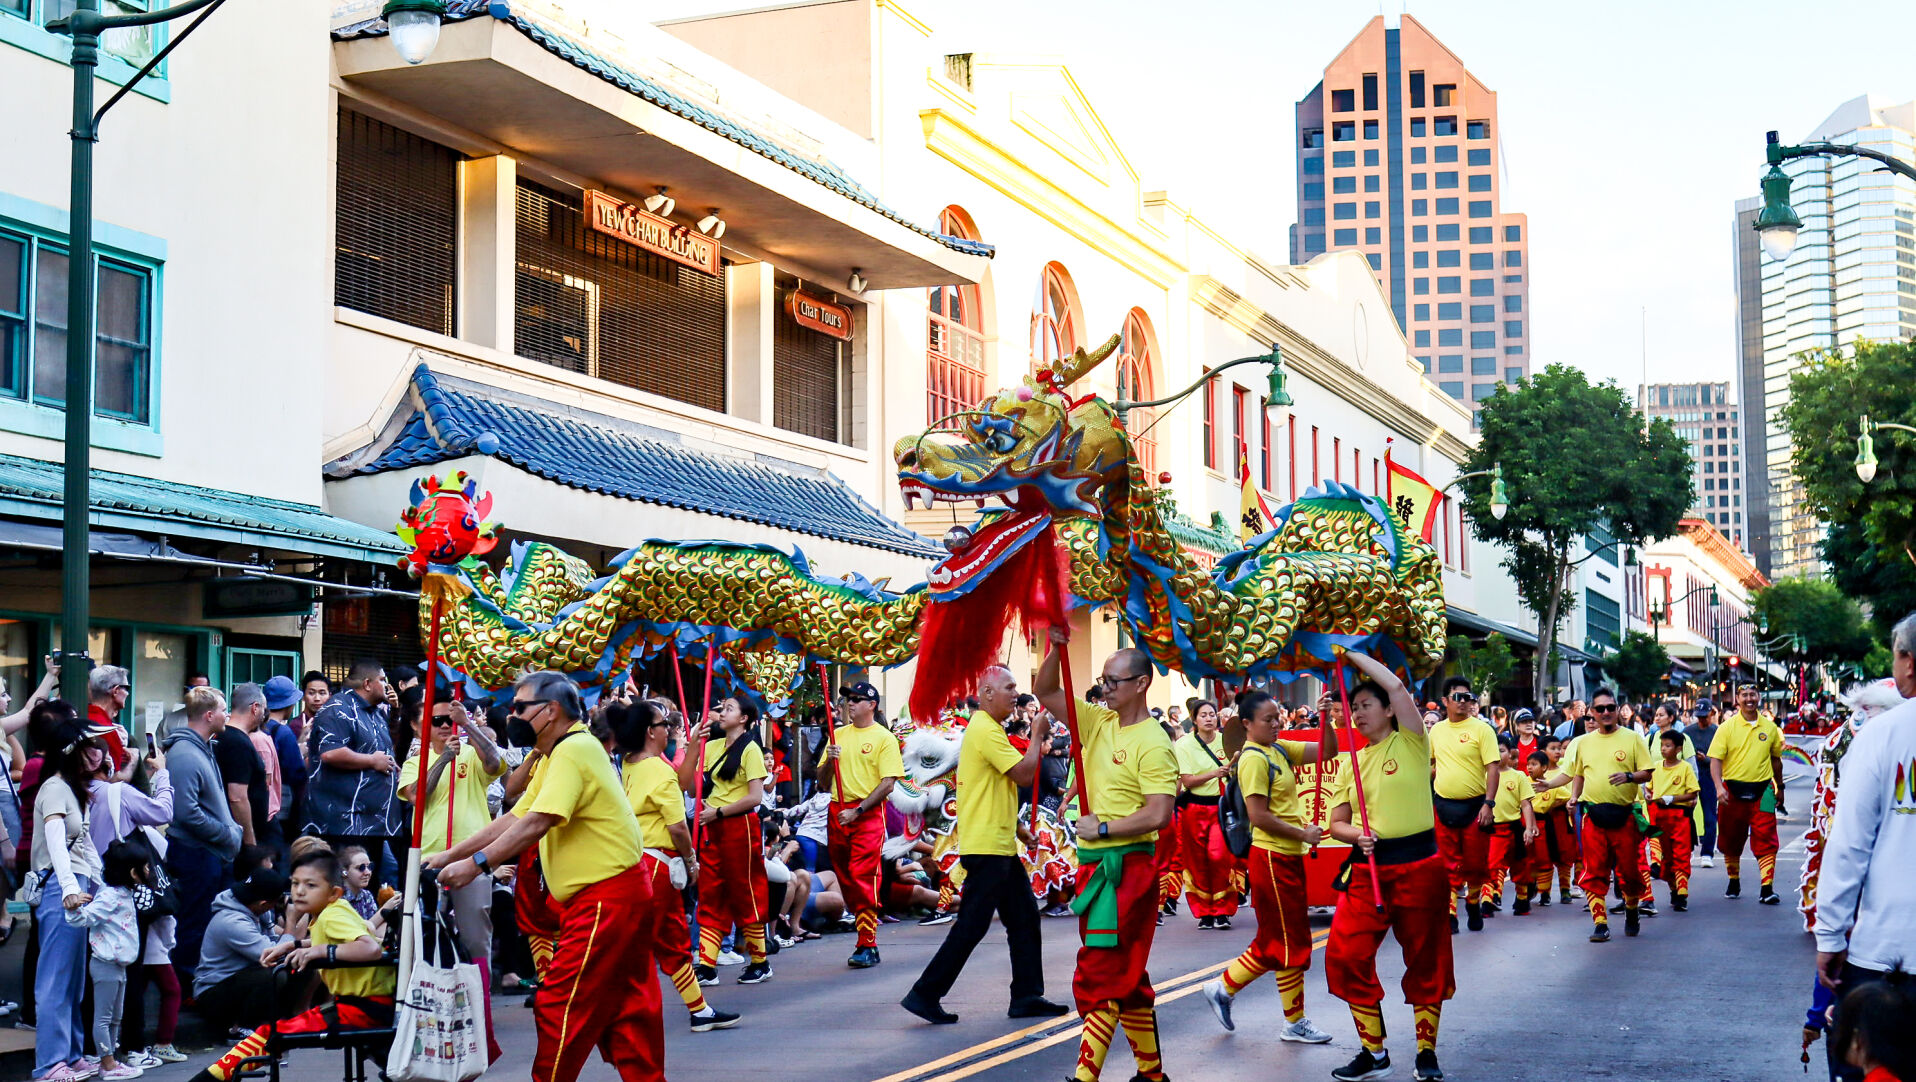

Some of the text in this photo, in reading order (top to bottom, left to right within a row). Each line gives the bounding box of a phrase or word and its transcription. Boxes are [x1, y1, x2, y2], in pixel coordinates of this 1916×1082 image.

[600, 204, 707, 265] YEW CHAR BUILDING
[801, 301, 842, 328] Char Tours
